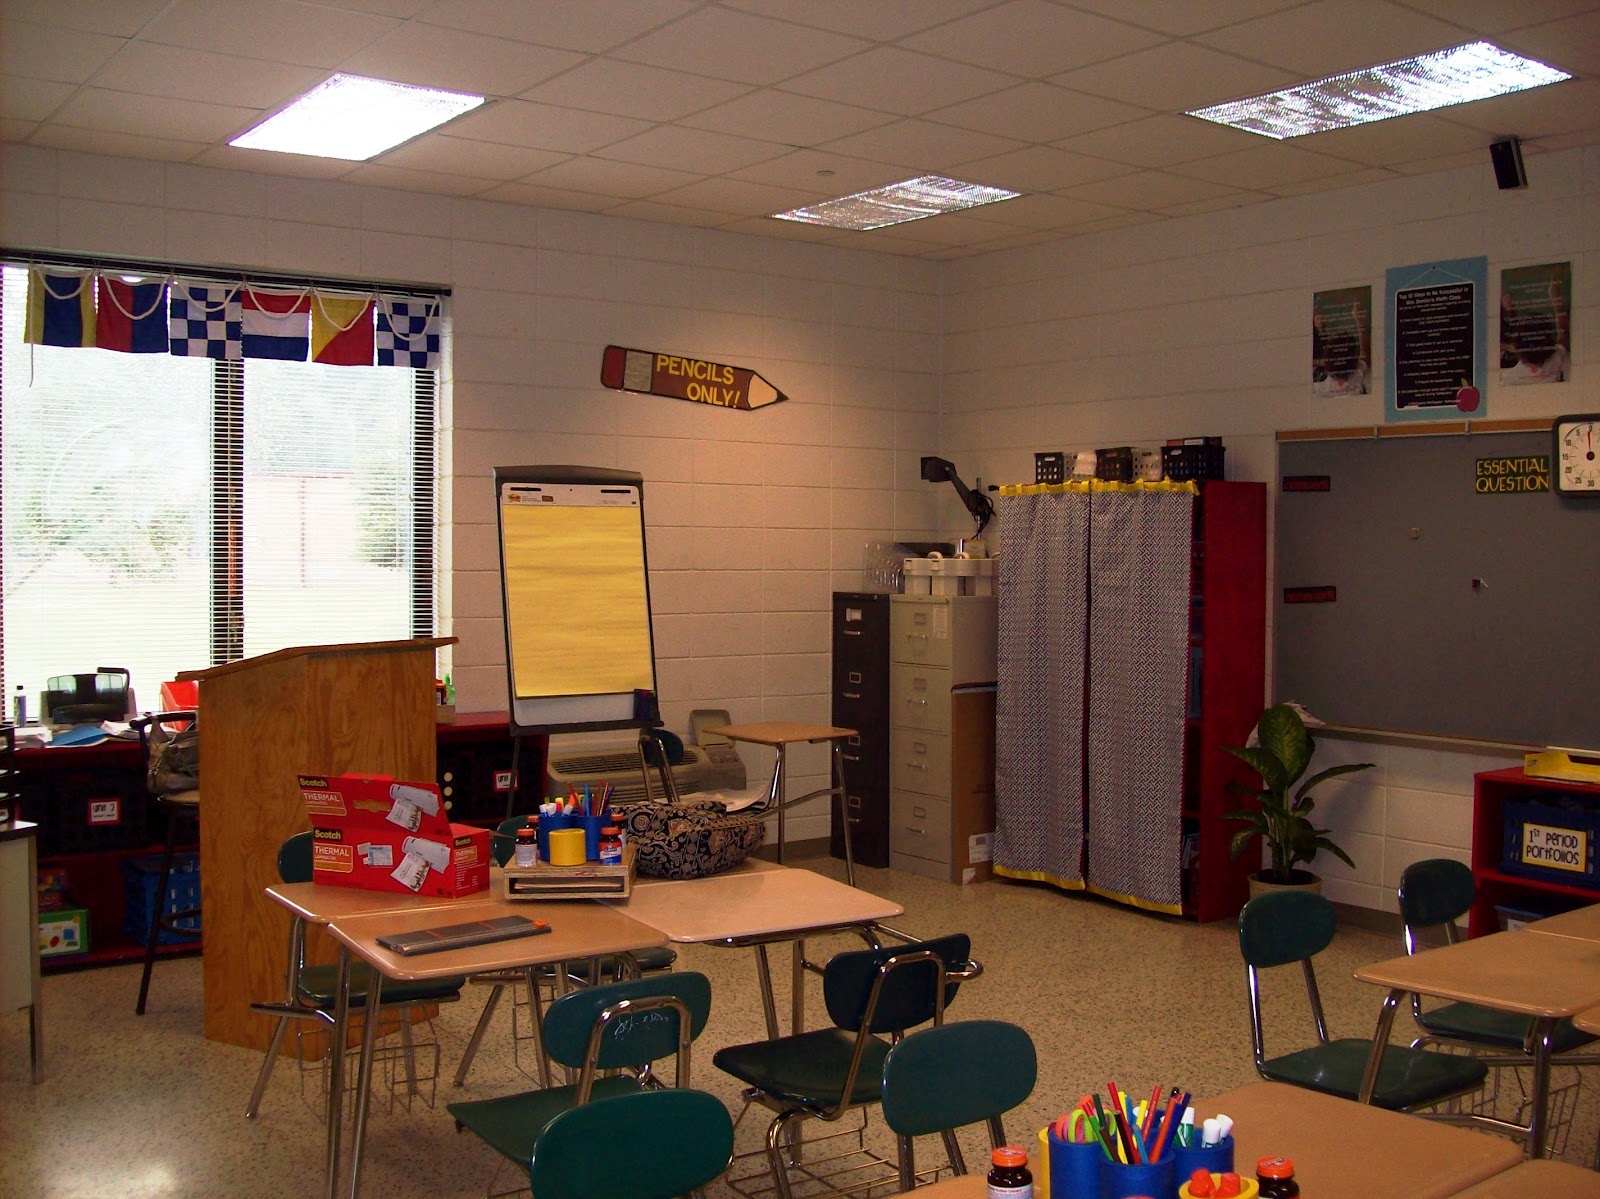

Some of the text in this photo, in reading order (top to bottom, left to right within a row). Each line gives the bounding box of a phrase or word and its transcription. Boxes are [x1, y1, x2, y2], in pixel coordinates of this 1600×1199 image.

[656, 354, 735, 385] PENCILS
[686, 382, 740, 409] ONLY!
[1476, 458, 1548, 475] ESSENTIAL
[1565, 466, 1572, 474] 20
[1476, 475, 1549, 492] QUESTION
[1575, 476, 1582, 484] 25
[1587, 479, 1595, 487] 30
[299, 778, 328, 788] Scotch
[303, 792, 340, 802] THERMAL
[314, 829, 342, 839] Scotch
[314, 846, 350, 857] THERMAL
